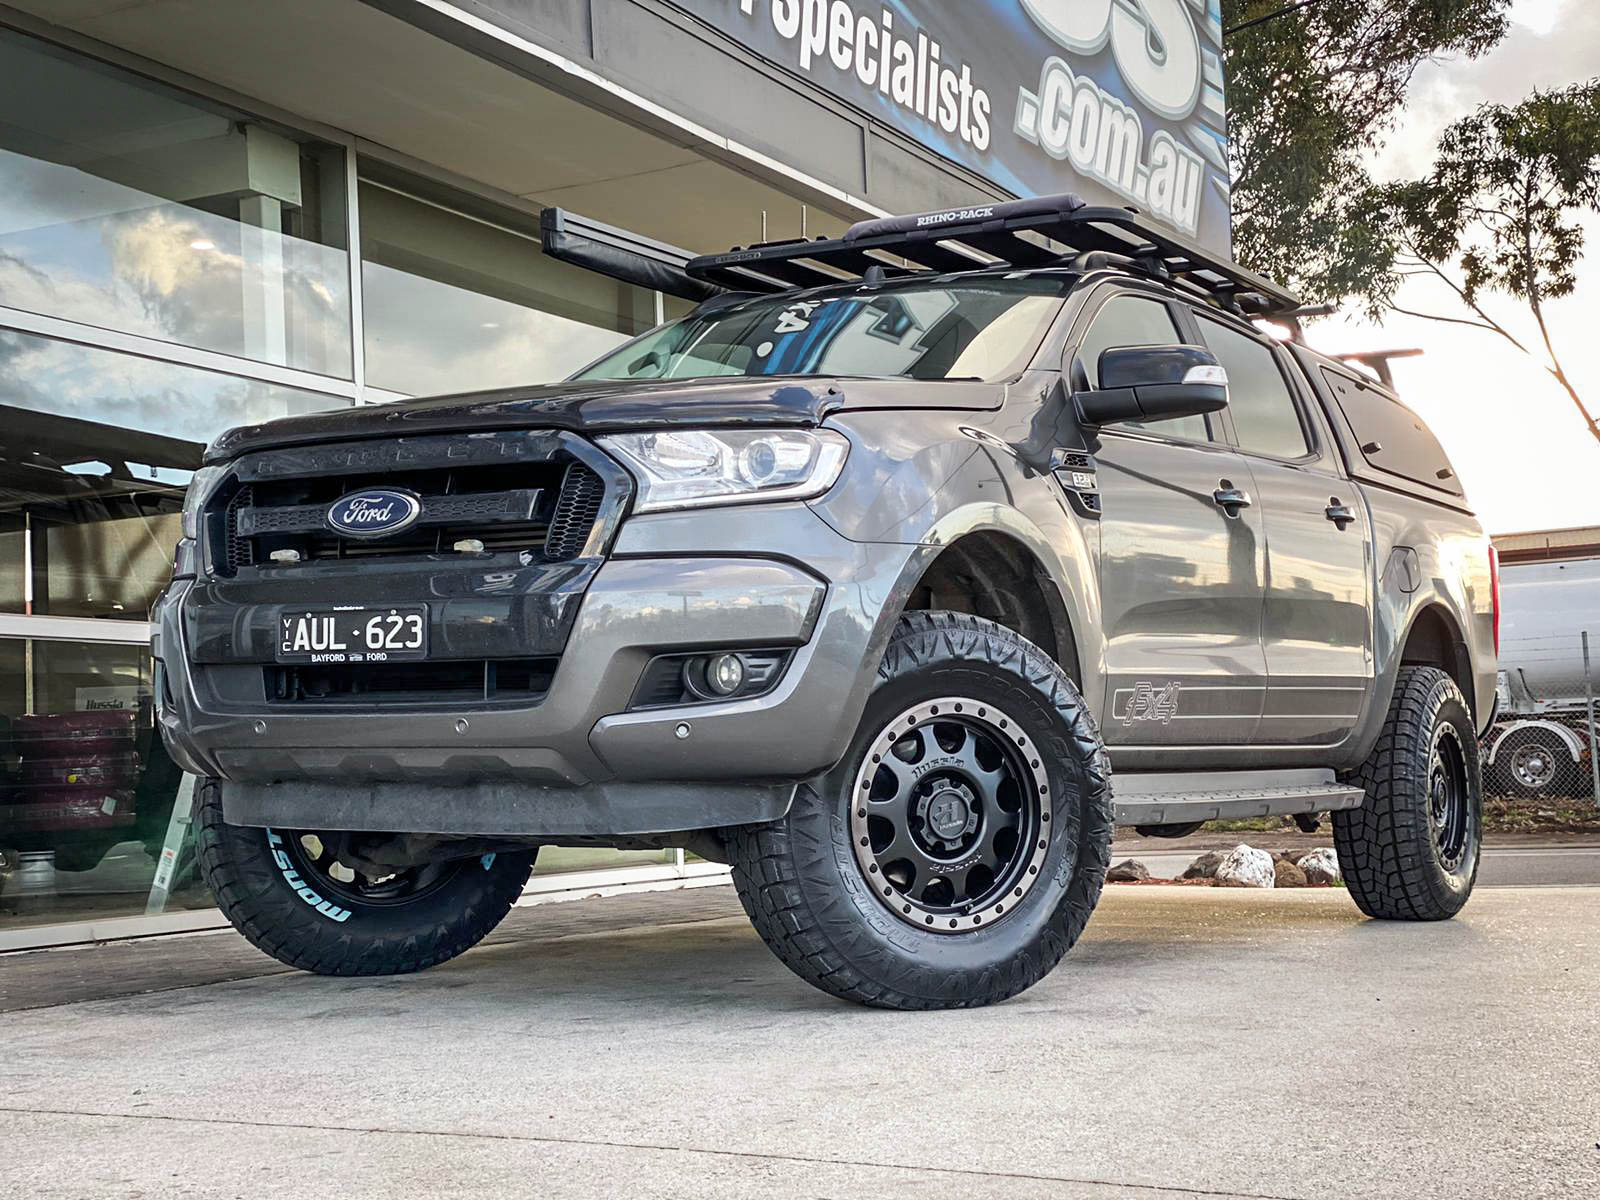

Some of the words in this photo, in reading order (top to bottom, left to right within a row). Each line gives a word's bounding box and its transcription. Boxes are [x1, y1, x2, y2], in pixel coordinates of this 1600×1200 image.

[1014, 56, 1206, 238] .com.au
[916, 207, 994, 227] RHINO-RACK
[343, 497, 395, 524] Ford
[293, 616, 348, 651] AUL
[365, 614, 424, 650] 623
[311, 653, 347, 663] BAYFORD
[366, 652, 389, 662] FORD
